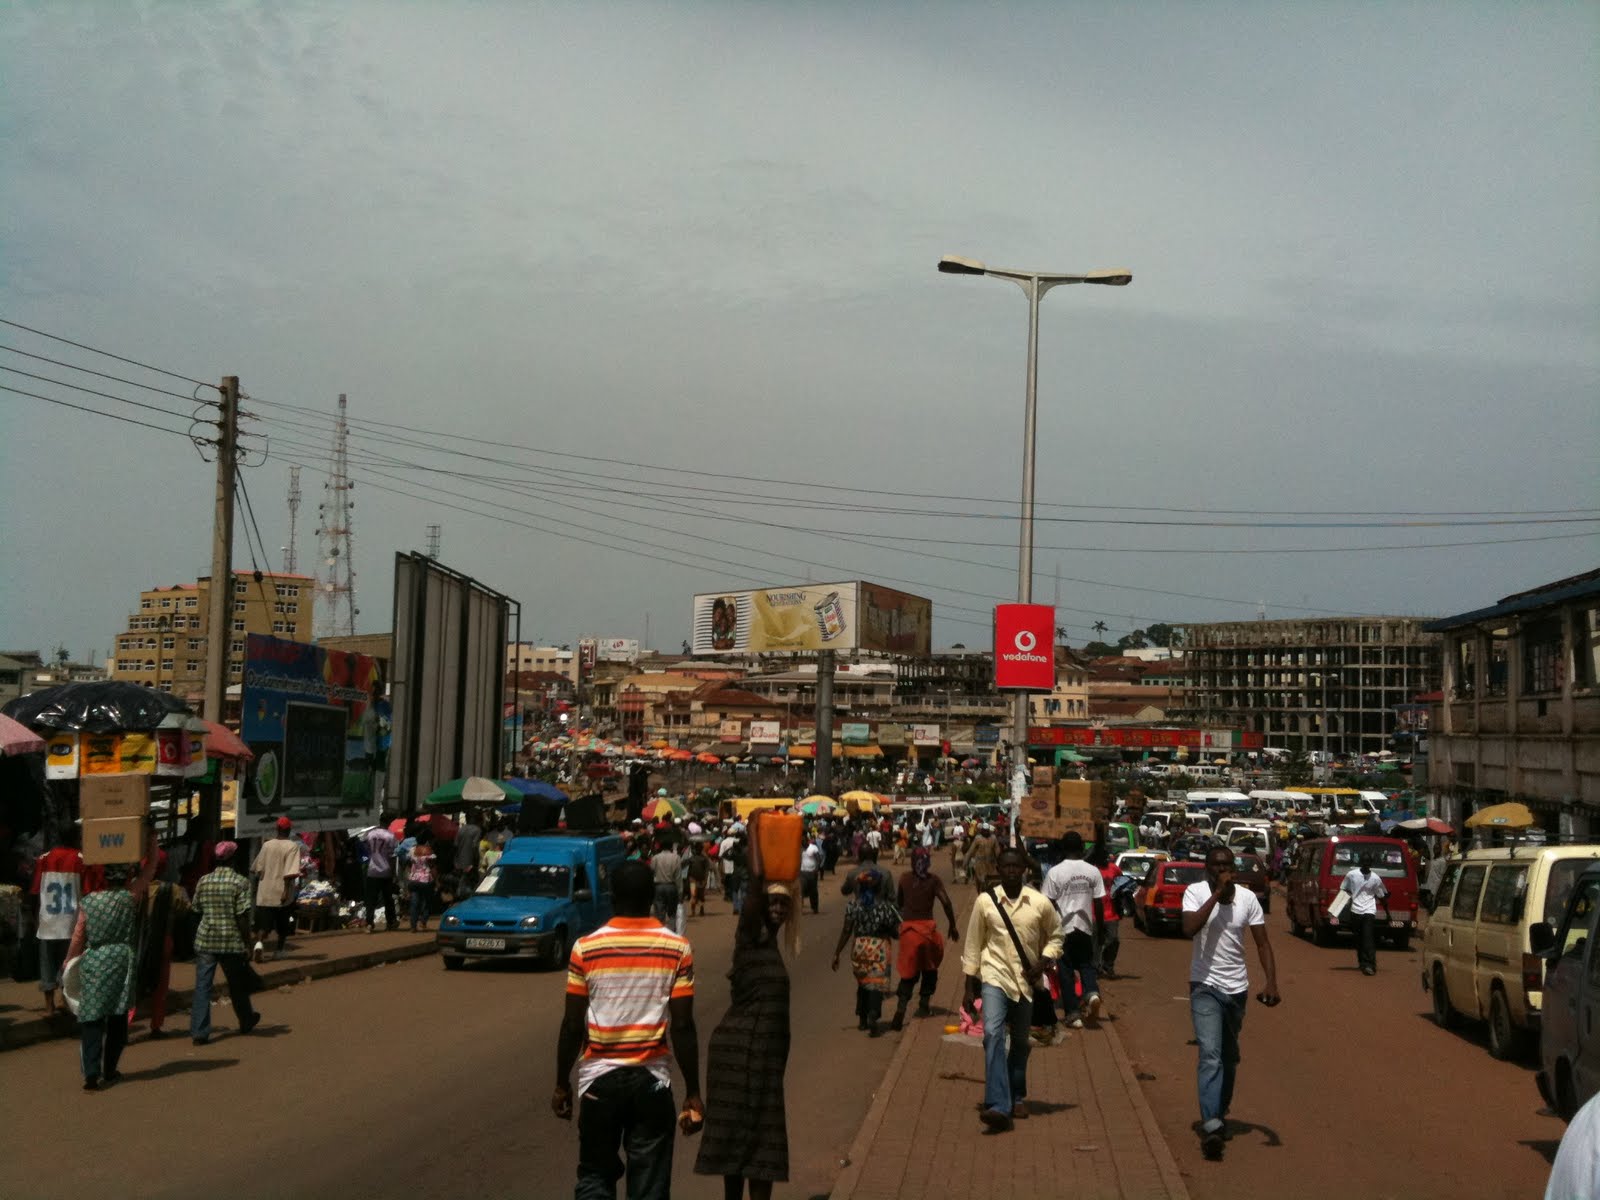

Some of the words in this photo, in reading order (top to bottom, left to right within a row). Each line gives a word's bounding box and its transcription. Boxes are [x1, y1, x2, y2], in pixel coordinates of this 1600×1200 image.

[766, 591, 806, 602] NOURISHING
[1003, 652, 1047, 662] vodafone
[46, 882, 74, 914] 31
